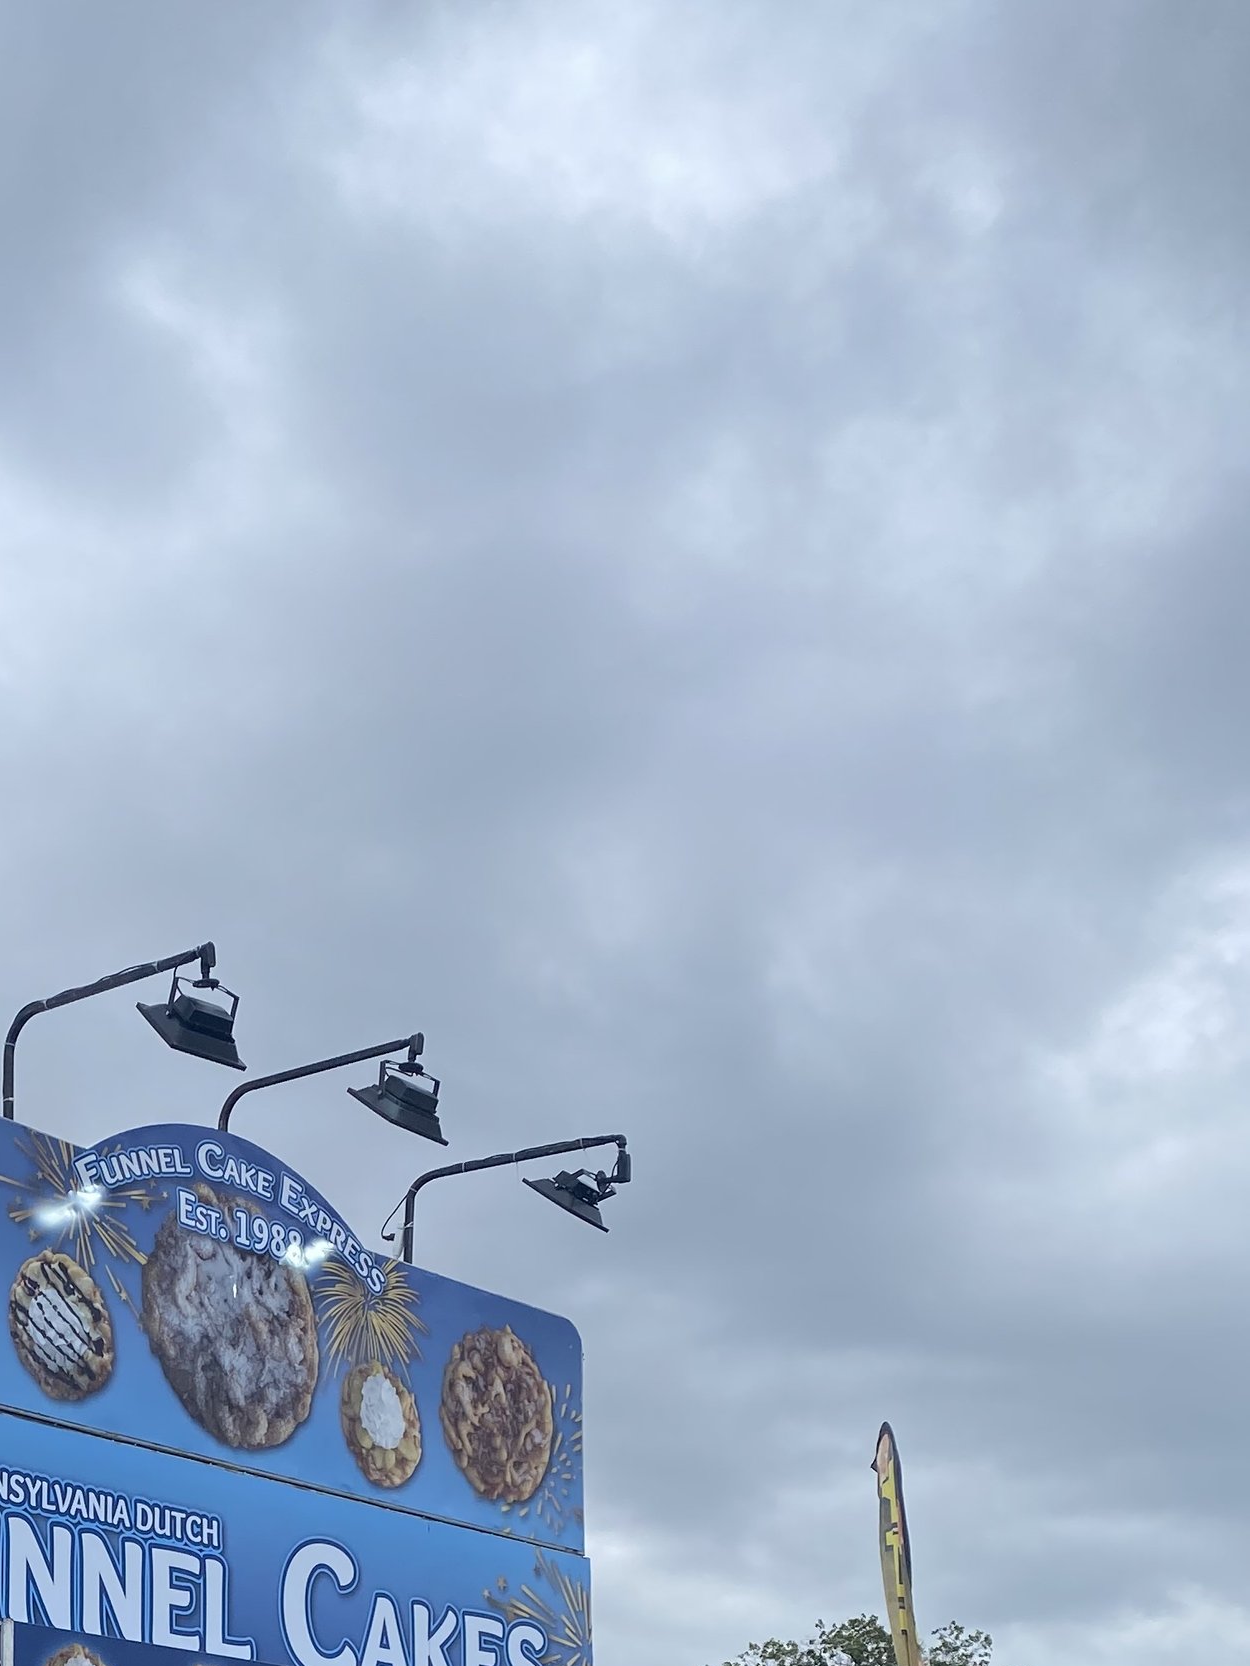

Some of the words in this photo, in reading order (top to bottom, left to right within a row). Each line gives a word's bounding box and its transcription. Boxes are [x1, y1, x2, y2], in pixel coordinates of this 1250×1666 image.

[73, 1147, 192, 1192] FUNNEL
[196, 1140, 275, 1201] CAKE
[279, 1172, 387, 1295] EXPRESS
[235, 1208, 303, 1266] 1988
[135, 1505, 221, 1548] DUTCH
